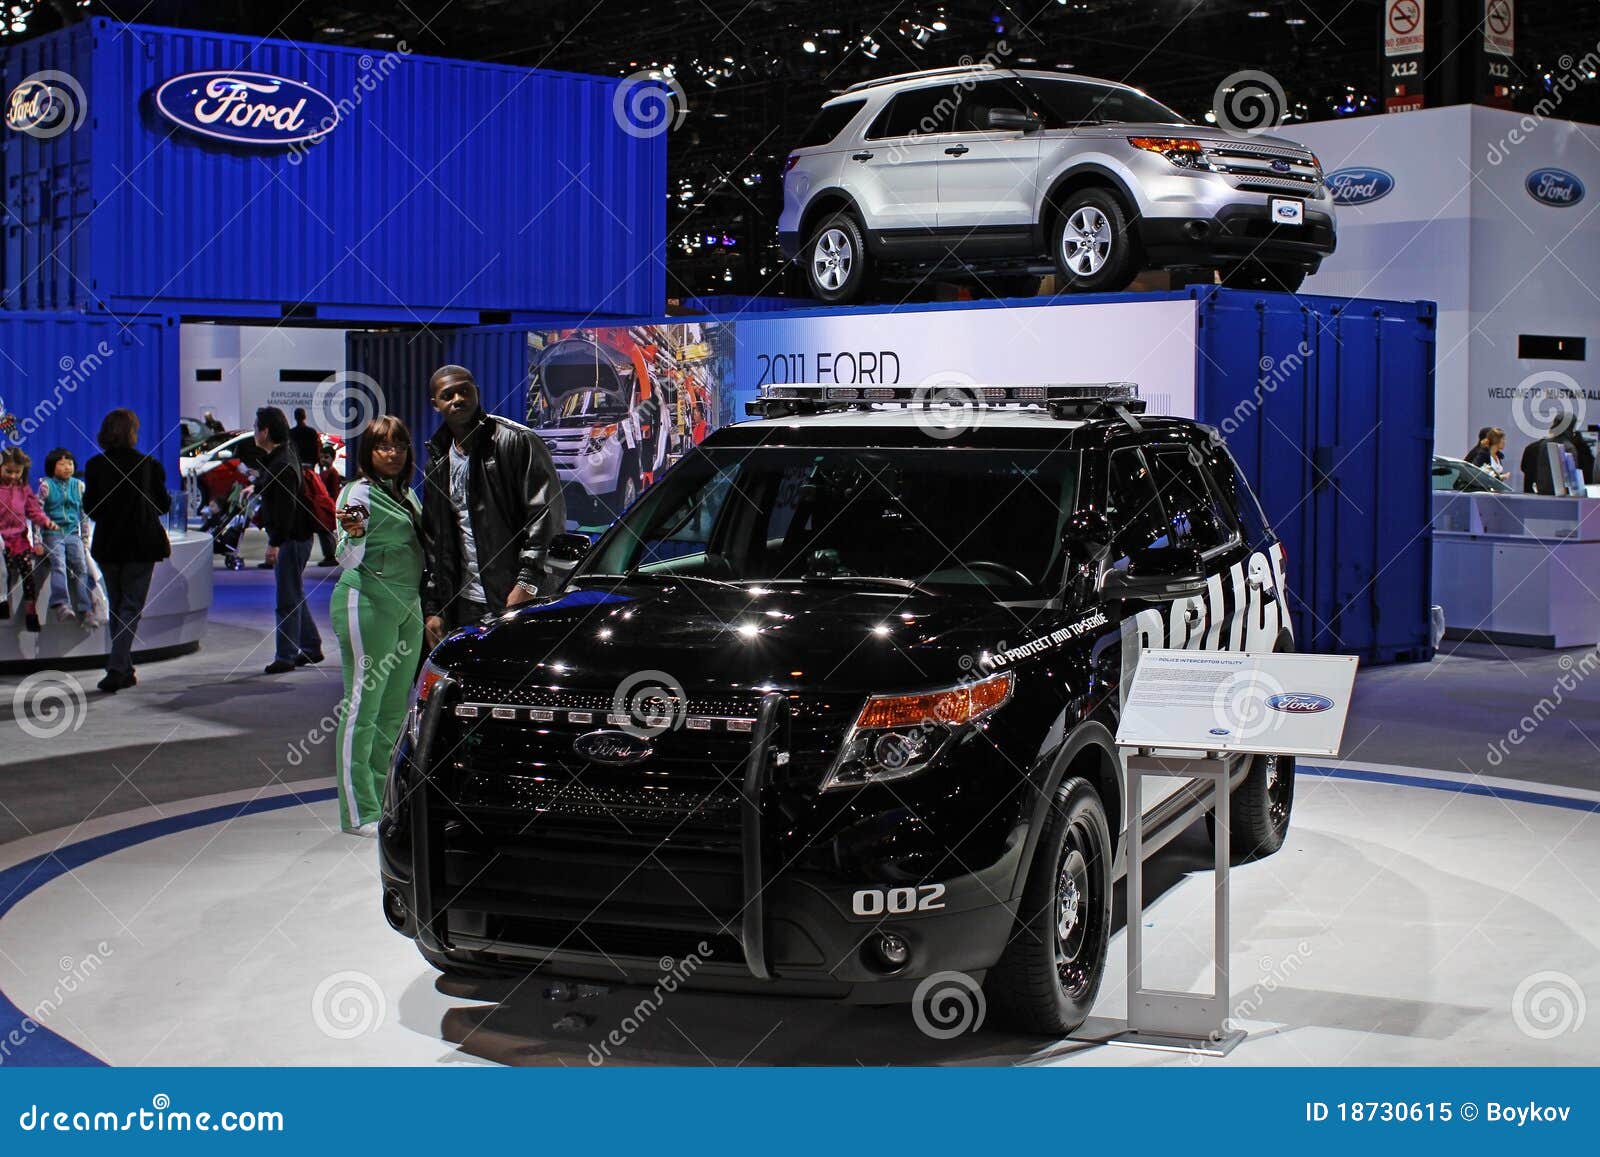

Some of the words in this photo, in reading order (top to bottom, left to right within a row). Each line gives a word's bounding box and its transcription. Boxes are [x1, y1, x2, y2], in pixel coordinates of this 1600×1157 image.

[1391, 61, 1418, 77] X12
[1488, 62, 1509, 77] X12
[9, 87, 40, 124] Ford
[194, 78, 307, 132] Ford
[1329, 173, 1378, 198] Ford
[1537, 172, 1574, 200] Ford
[756, 353, 805, 389] 2011
[816, 351, 900, 384] FORD
[1488, 387, 1529, 399] WELCOME
[1531, 388, 1542, 399] TO
[1004, 635, 1053, 662] PROTECT
[1050, 627, 1072, 643] AND
[1278, 695, 1319, 710] Ford
[853, 883, 946, 915] 002
